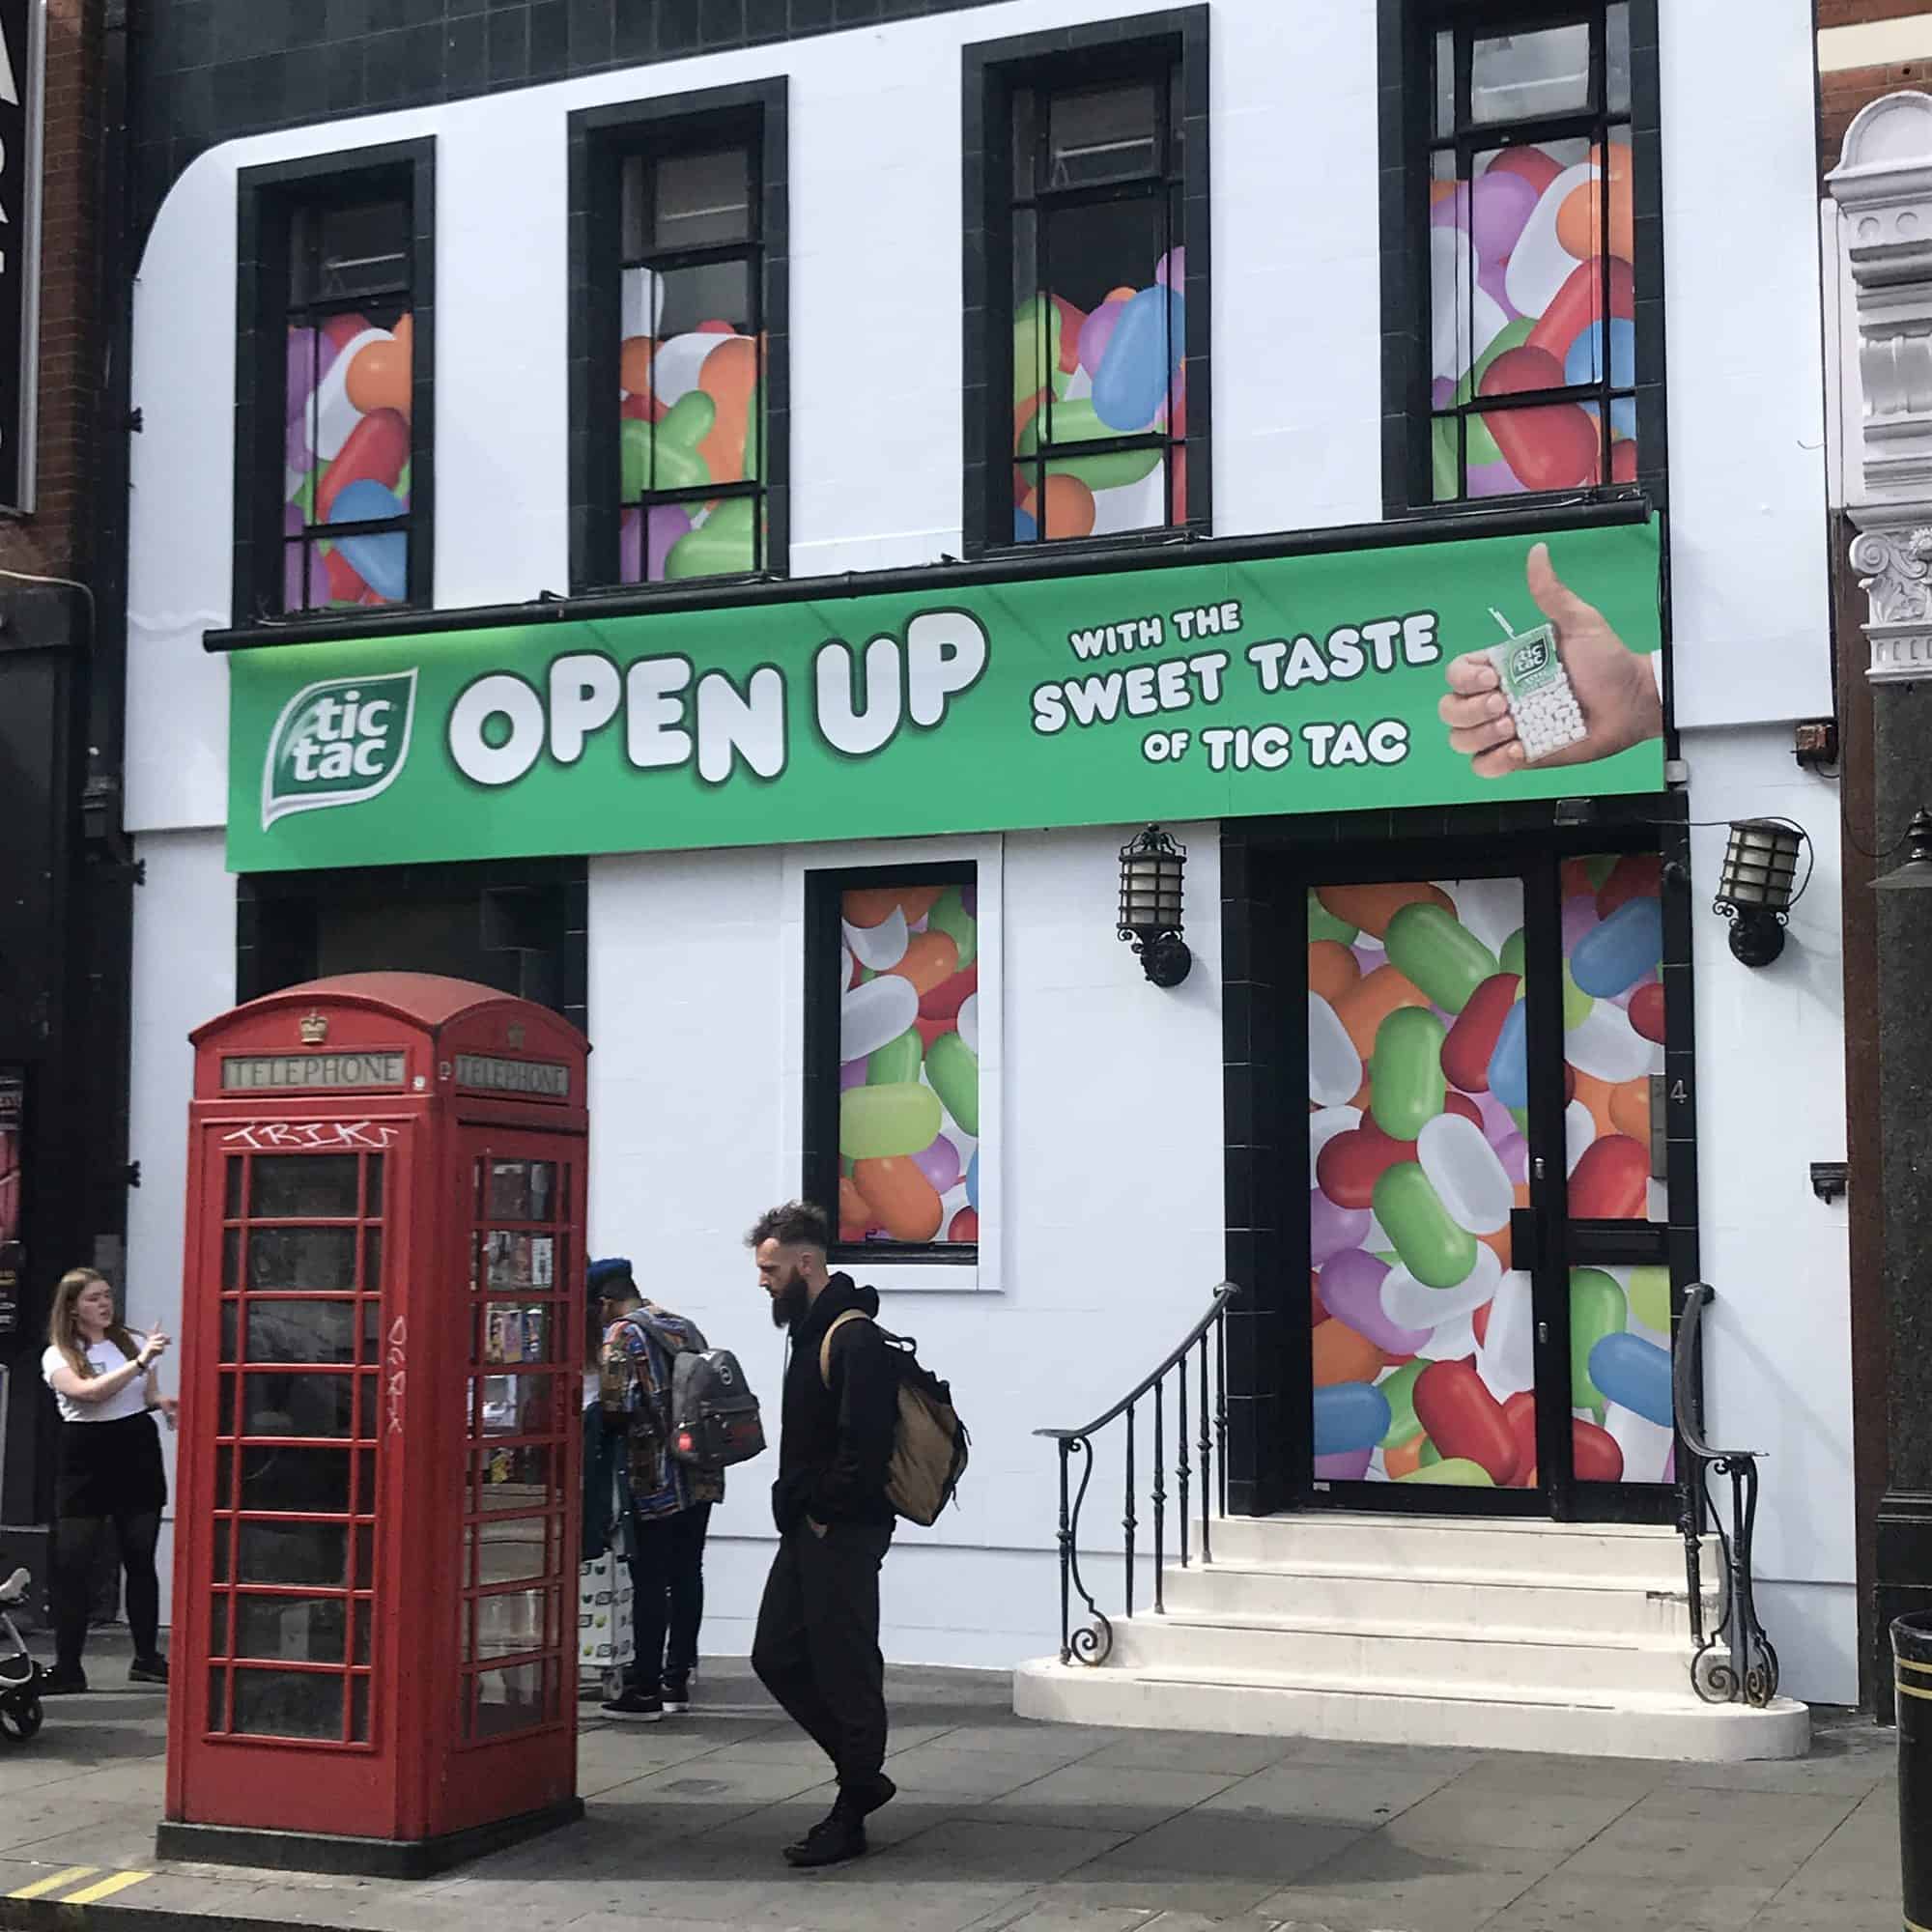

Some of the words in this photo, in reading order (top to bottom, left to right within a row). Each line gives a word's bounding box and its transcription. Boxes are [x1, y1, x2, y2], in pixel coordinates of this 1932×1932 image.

[1070, 617, 1162, 659] WITH
[1173, 603, 1240, 639] THE
[448, 653, 784, 784] OPEN
[816, 611, 986, 753] UP
[1033, 654, 1228, 732] SWEET
[1248, 614, 1439, 690] TASTE
[316, 690, 390, 742] tic
[292, 737, 387, 781] tac
[1144, 732, 1189, 761] OF
[1203, 726, 1290, 770] TIC
[1303, 721, 1407, 766] TAC
[229, 1054, 400, 1086] TELEPHONE
[459, 1057, 565, 1094] TELEPHONE
